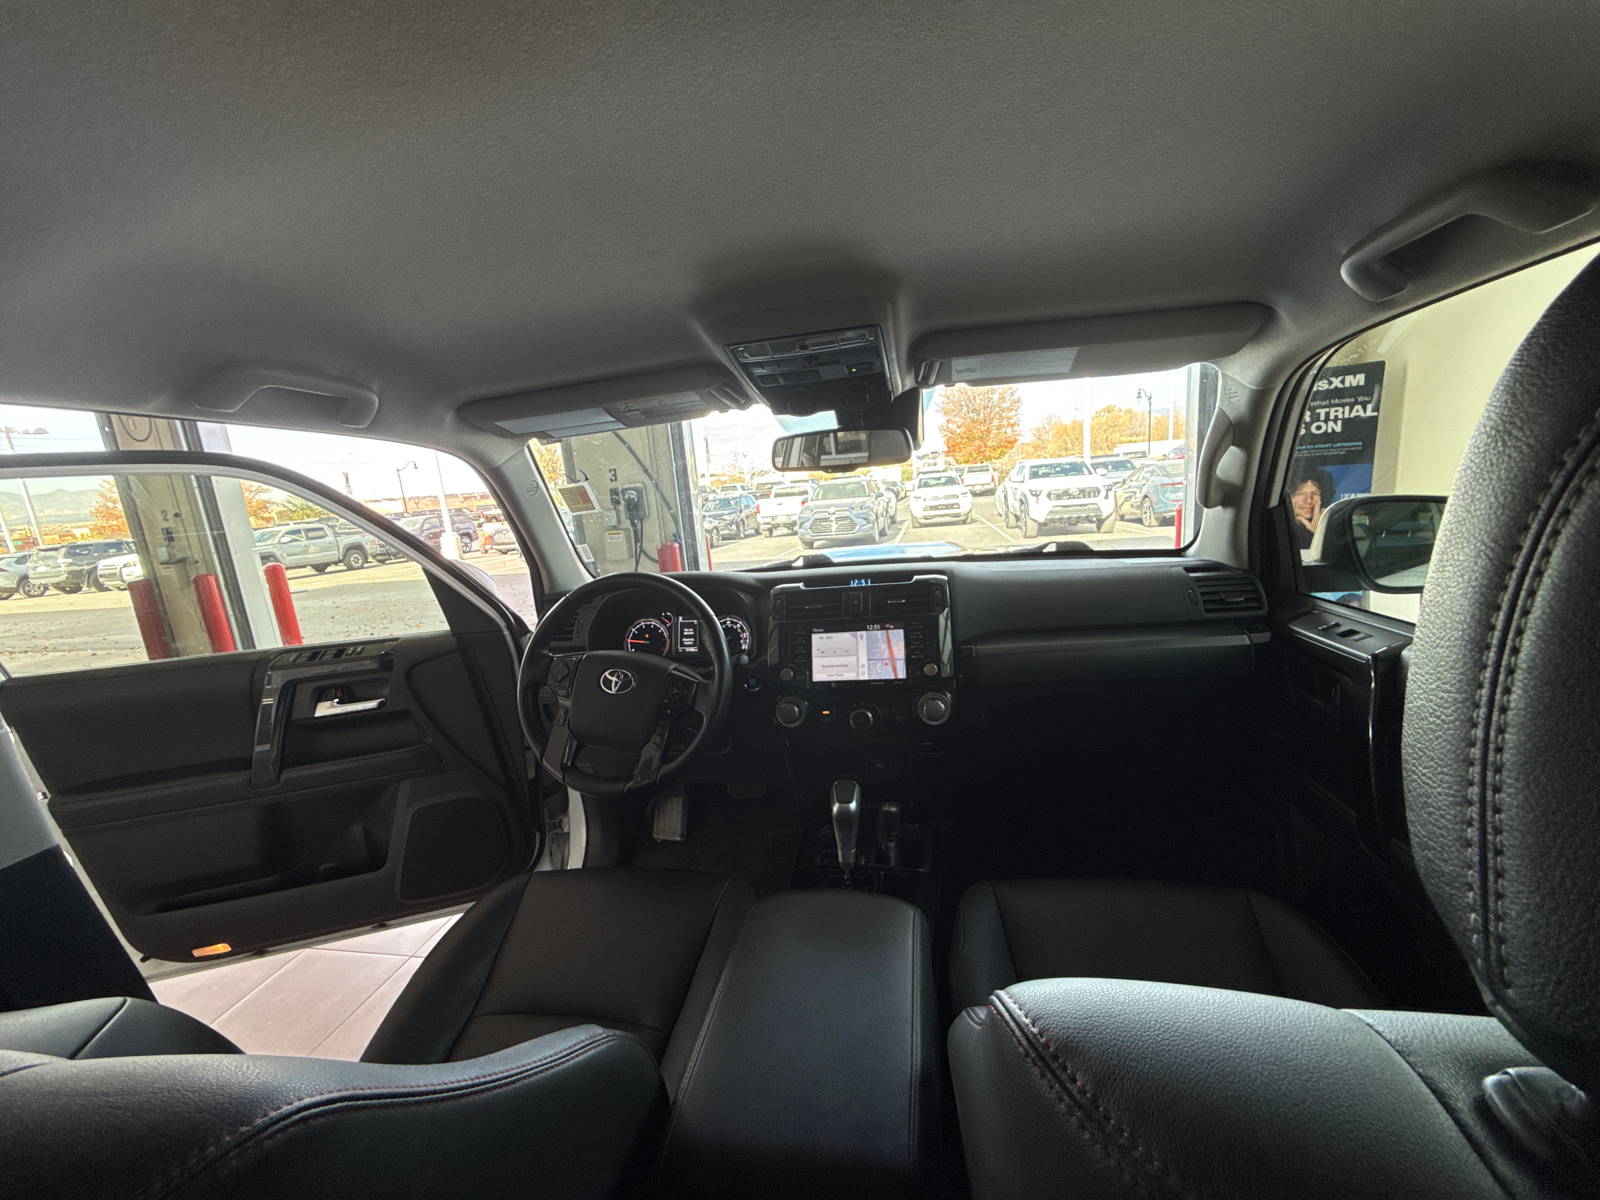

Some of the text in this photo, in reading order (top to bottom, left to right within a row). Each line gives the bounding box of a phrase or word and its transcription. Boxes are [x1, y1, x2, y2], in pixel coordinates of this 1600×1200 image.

[1310, 399, 1329, 407] What
[1331, 397, 1355, 405] Moves
[1316, 403, 1378, 421] TRIAL
[1311, 420, 1342, 434] ON
[609, 468, 618, 482] 3
[161, 509, 170, 521] 2
